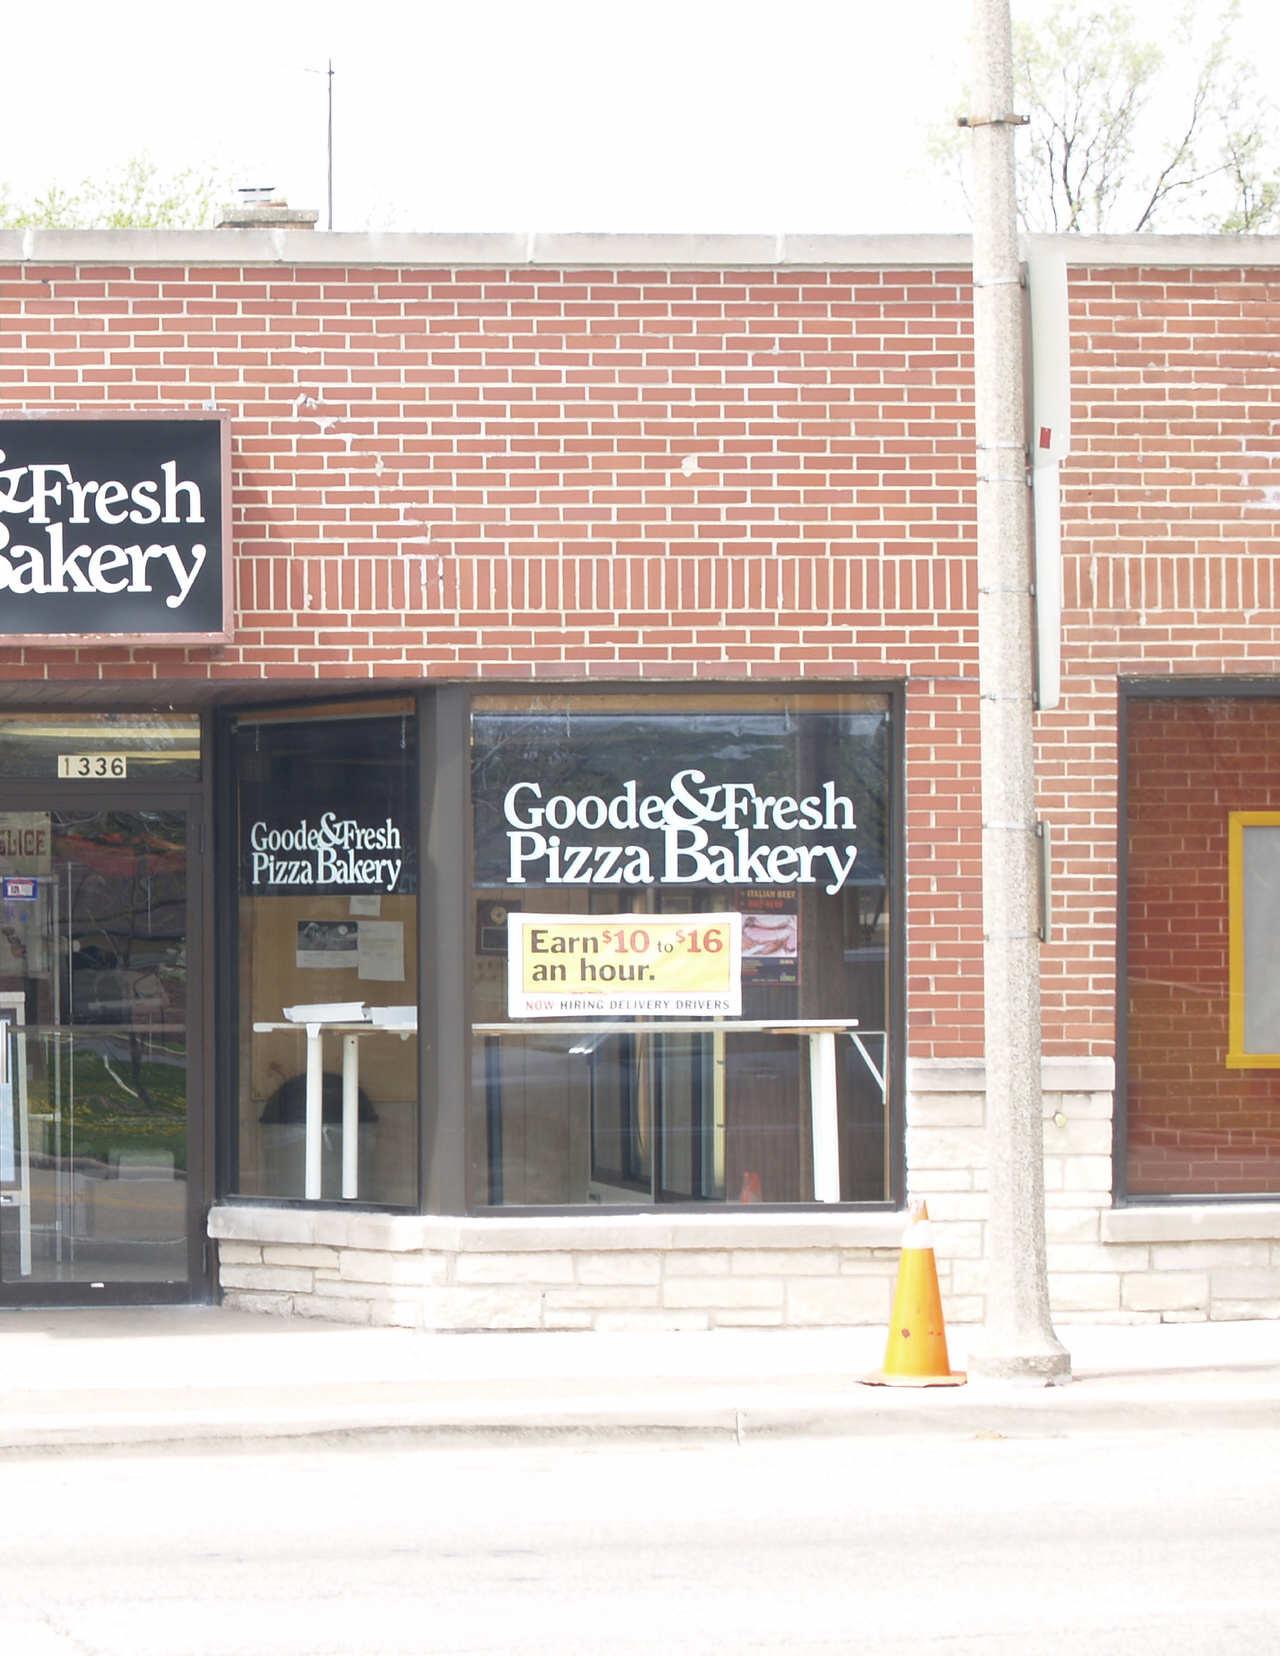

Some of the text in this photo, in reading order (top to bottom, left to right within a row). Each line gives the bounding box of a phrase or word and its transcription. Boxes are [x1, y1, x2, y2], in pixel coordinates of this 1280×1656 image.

[64, 757, 124, 776] 1336
[252, 847, 402, 892] Pizza Bakery
[506, 824, 858, 895] Pizza Bakery
[531, 929, 723, 953] Earn $10 to $16
[532, 958, 656, 982] an hour.
[526, 1000, 730, 1010] NOW HIRING DELIVERY DRIVERS
